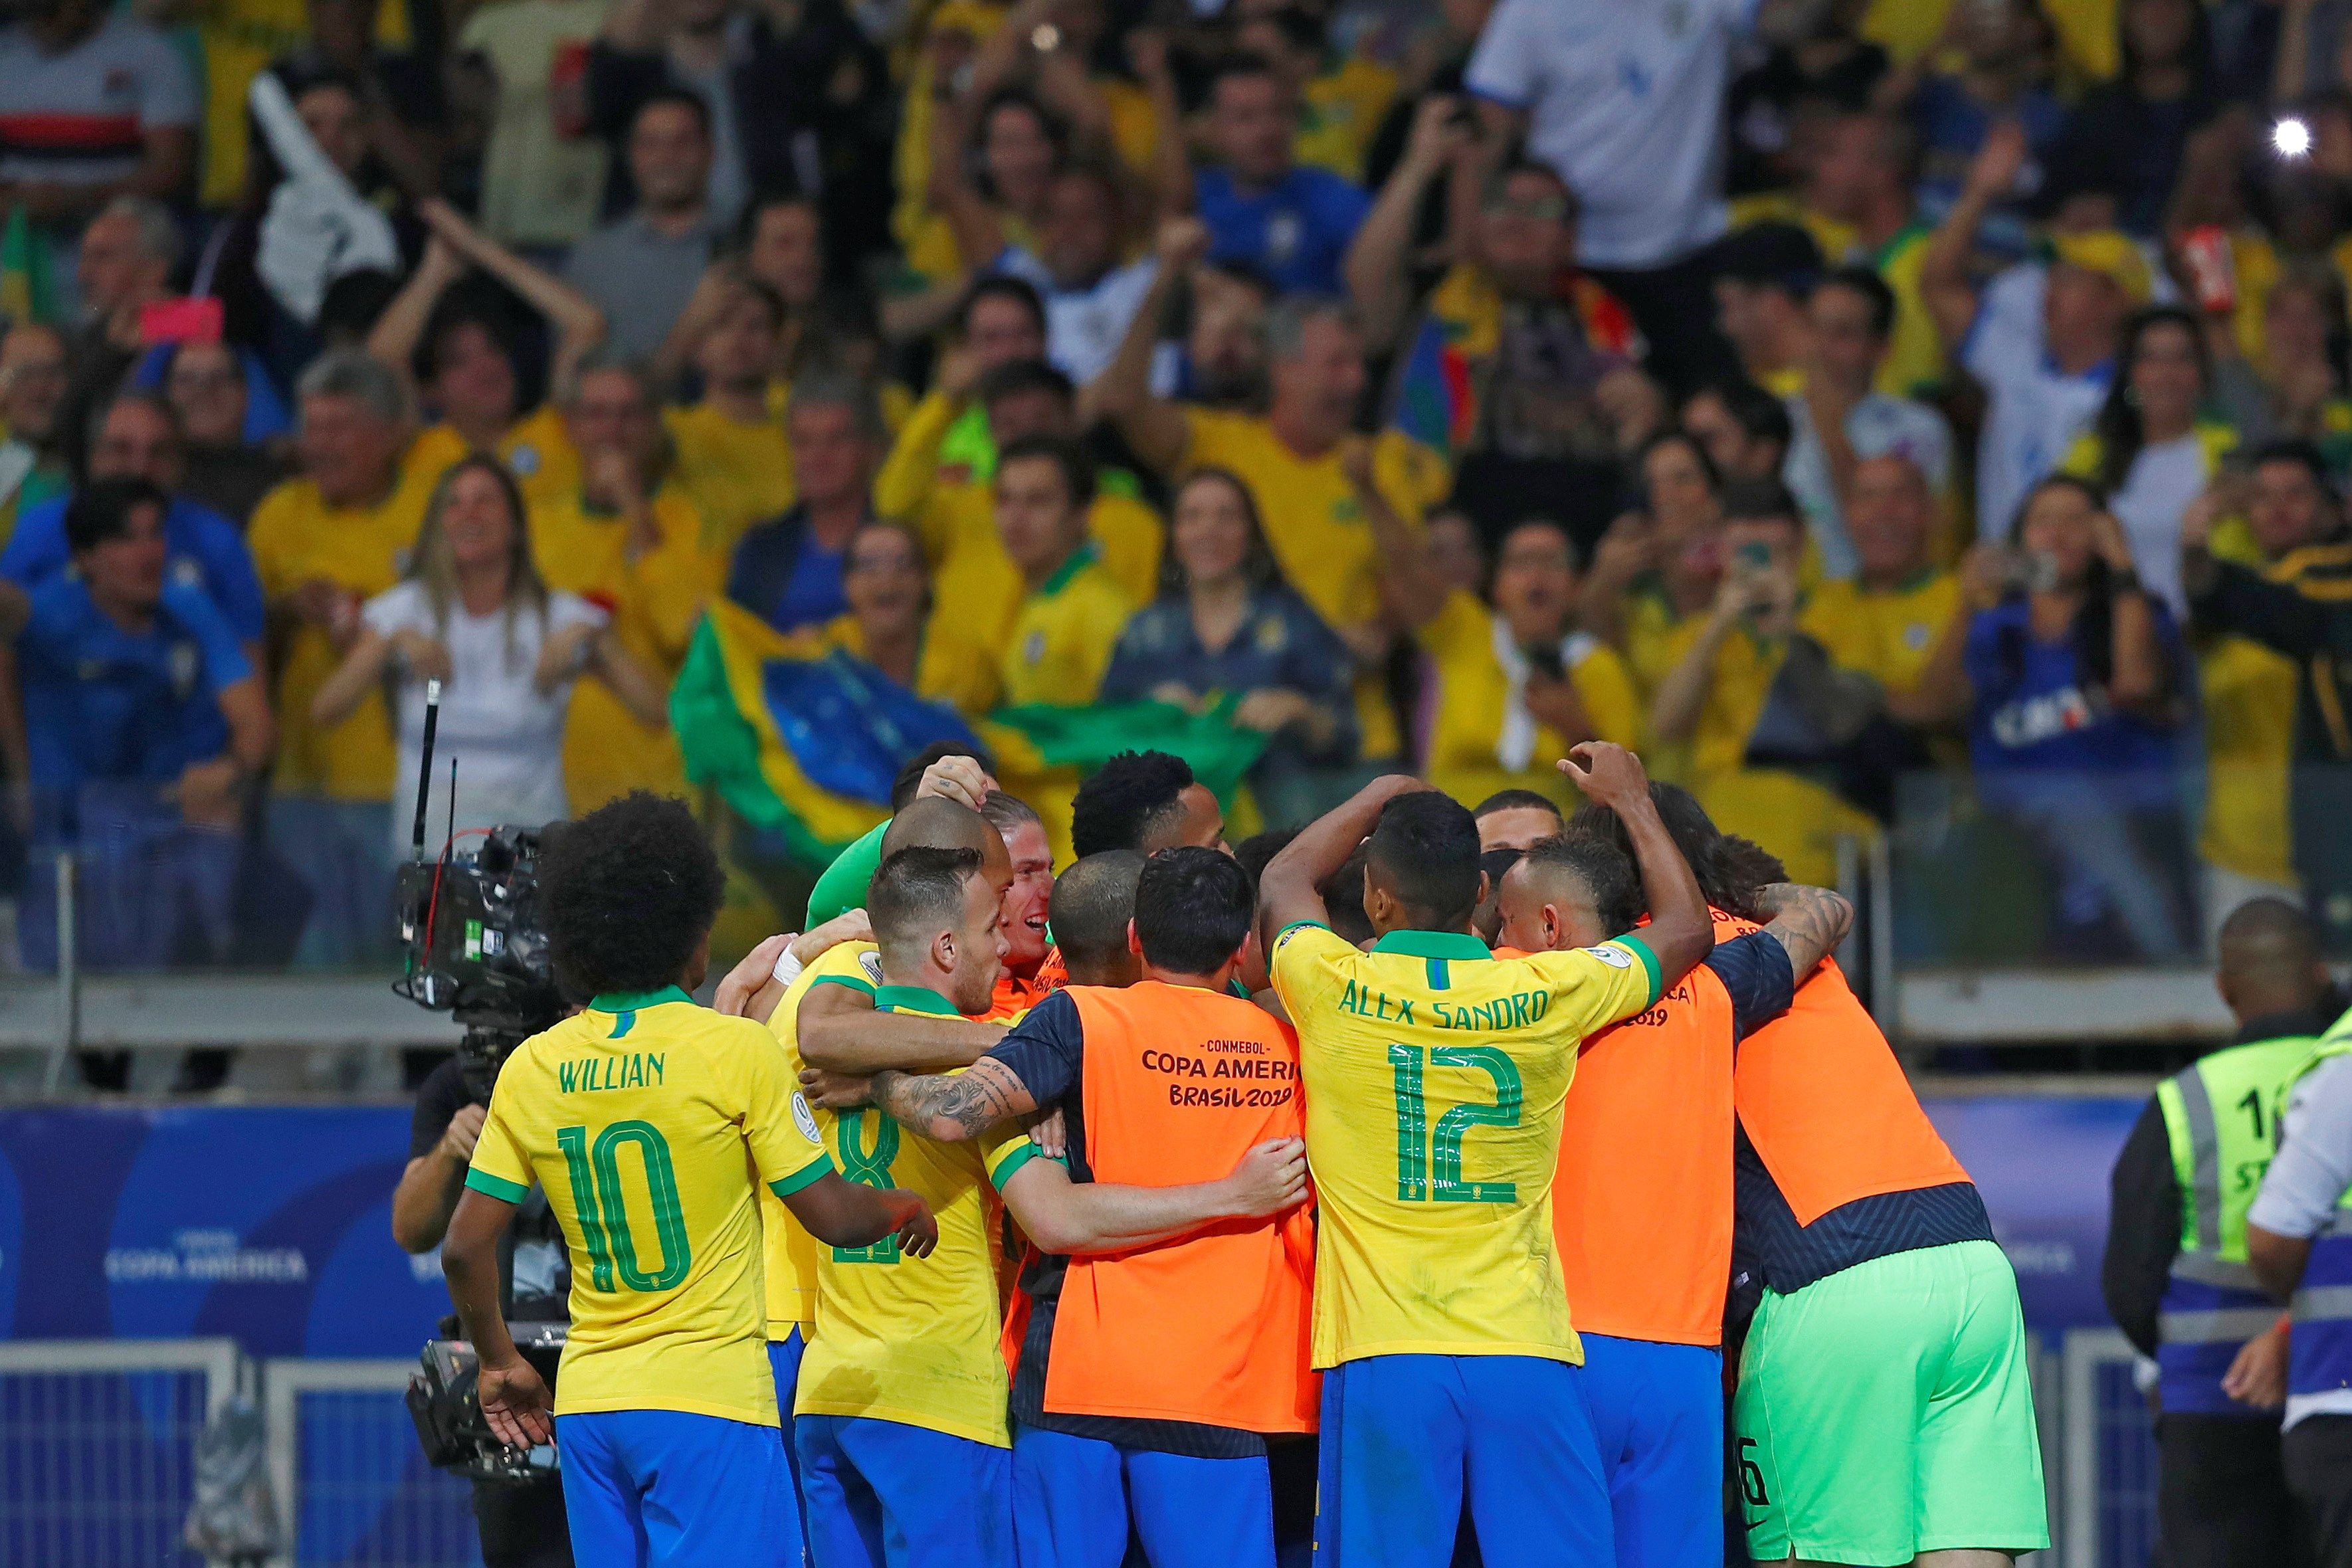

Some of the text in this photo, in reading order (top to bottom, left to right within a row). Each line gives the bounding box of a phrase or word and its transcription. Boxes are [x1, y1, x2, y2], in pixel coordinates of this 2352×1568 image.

[1338, 979, 1548, 1030] ALEX SANDRO
[559, 1052, 665, 1094] WILLIAN
[1141, 1049, 1302, 1081] COPA AMERI
[1246, 1087, 1292, 1107] 2019
[1388, 1044, 1523, 1203] 12
[557, 1120, 692, 1293] 10
